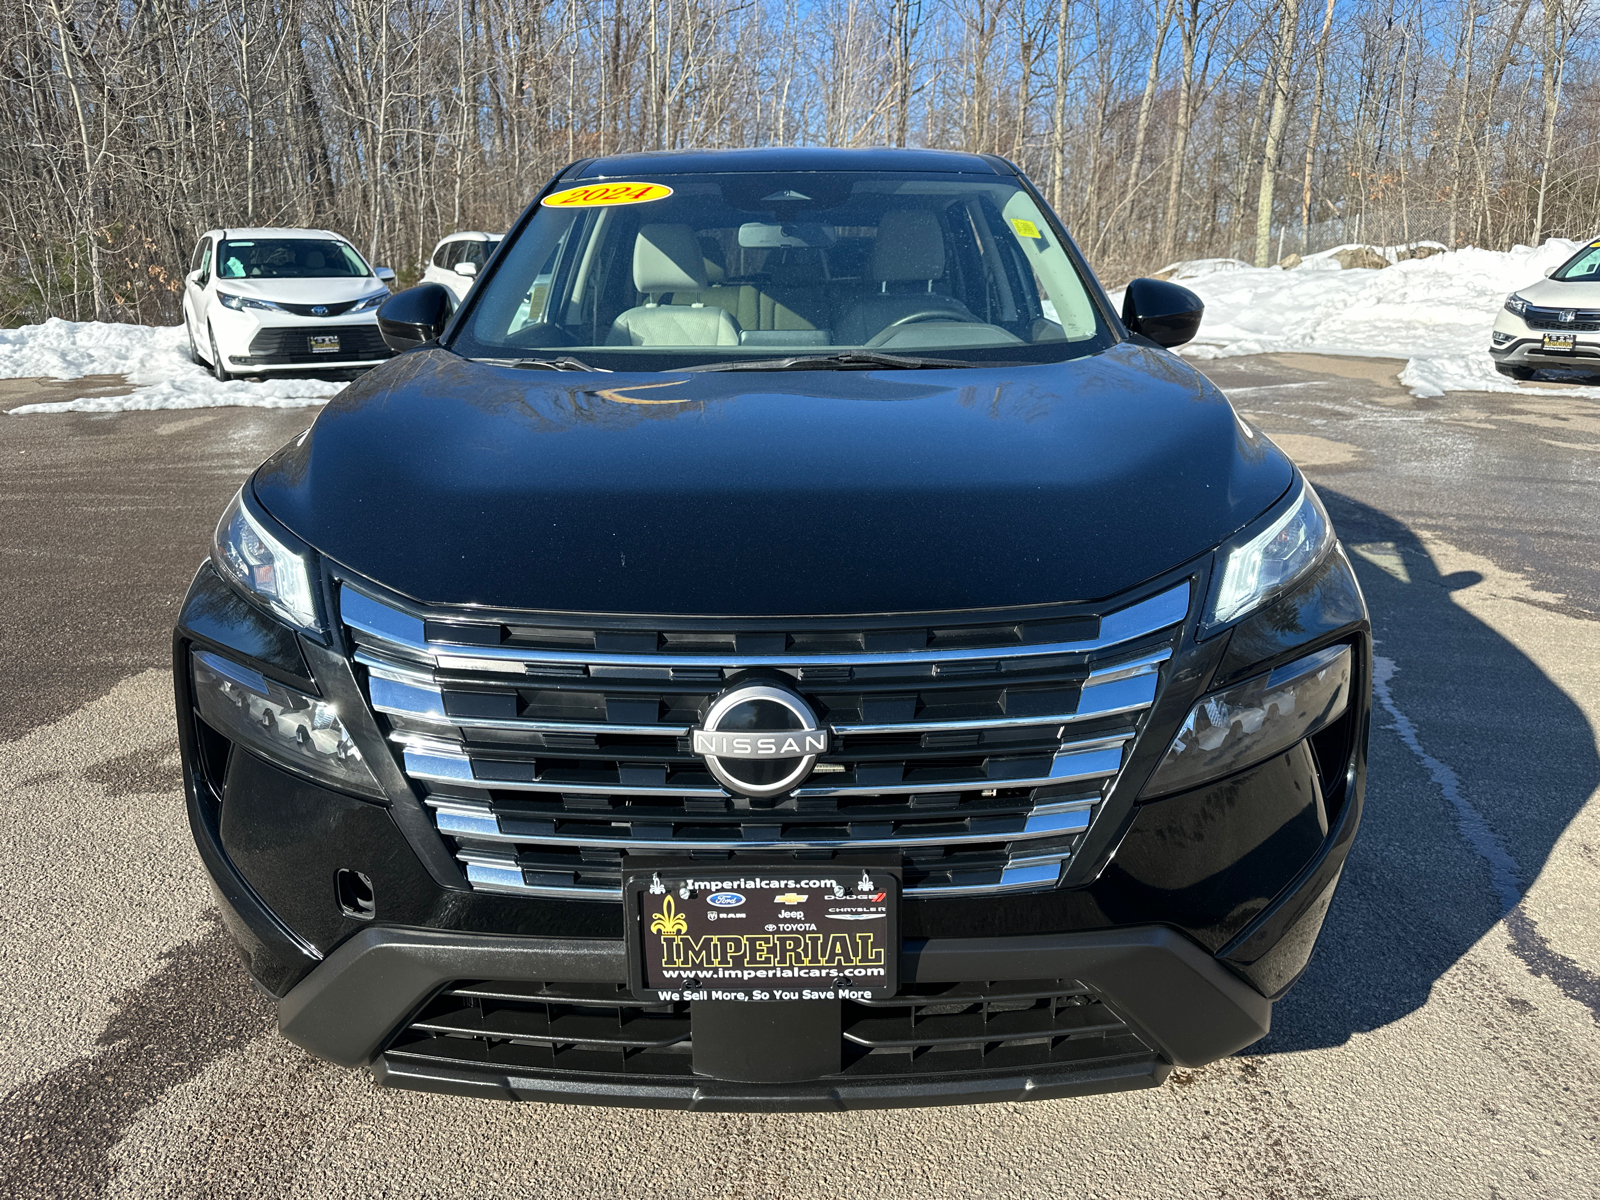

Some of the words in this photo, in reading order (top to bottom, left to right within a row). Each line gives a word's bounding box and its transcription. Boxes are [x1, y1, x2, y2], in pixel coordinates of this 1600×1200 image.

[558, 186, 654, 205] 2024
[696, 734, 825, 755] NISSAN
[686, 877, 837, 892] Imperialcars.com
[715, 895, 738, 905] Ford
[778, 909, 804, 920] Jeep
[778, 923, 817, 931] TOYOTA
[660, 933, 885, 968] IMPERIAL
[662, 967, 885, 980] www.imperialcars.com
[658, 990, 680, 1001] We
[683, 990, 708, 1001] Sell
[711, 990, 749, 1002] More,
[752, 990, 770, 1000] So
[773, 989, 799, 1000] You
[802, 989, 835, 1000] Save
[838, 988, 872, 999] More
